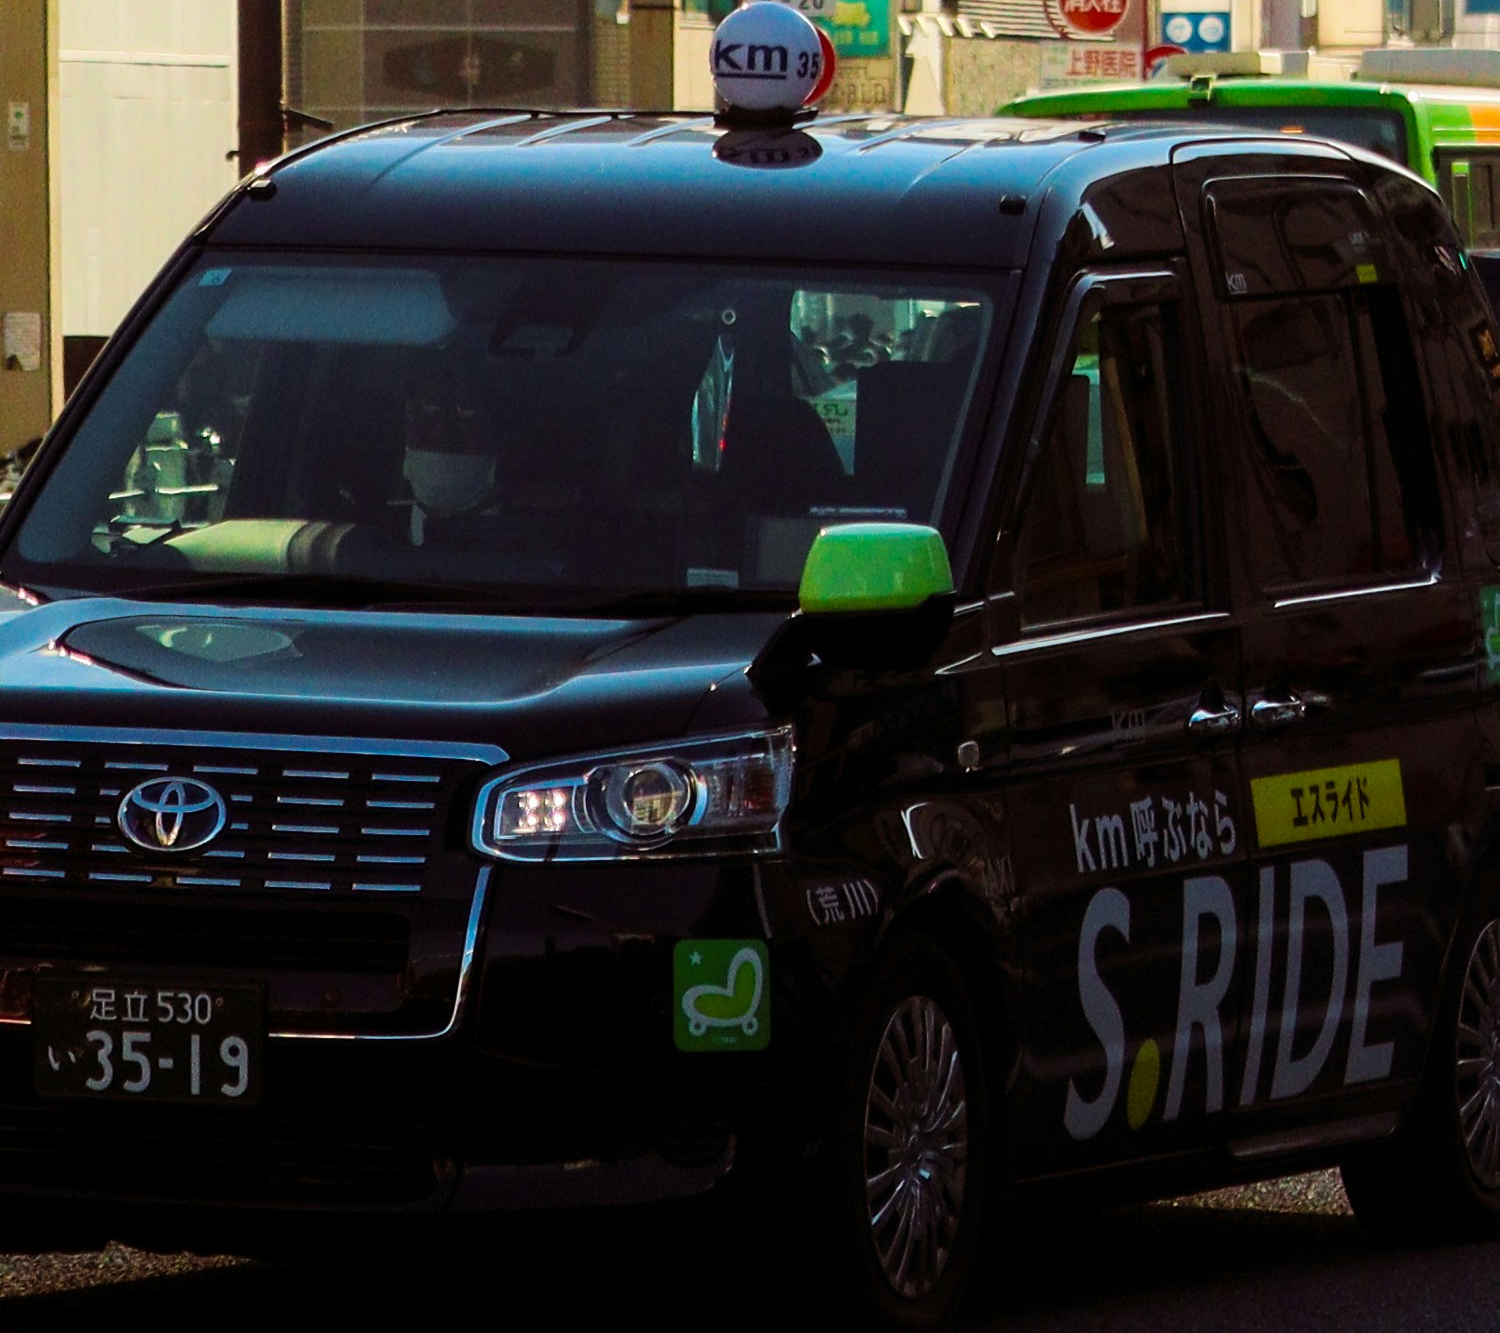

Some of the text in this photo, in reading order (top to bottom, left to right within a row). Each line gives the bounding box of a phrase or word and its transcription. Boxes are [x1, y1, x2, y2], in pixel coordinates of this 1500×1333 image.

[711, 39, 789, 80] km
[1068, 789, 1235, 874] km呼ぶなら
[1289, 776, 1369, 830] エスライド
[90, 988, 212, 1024] 足立 530
[1062, 844, 1408, 1141] S.RIDE
[48, 1029, 249, 1097] い 35-19
